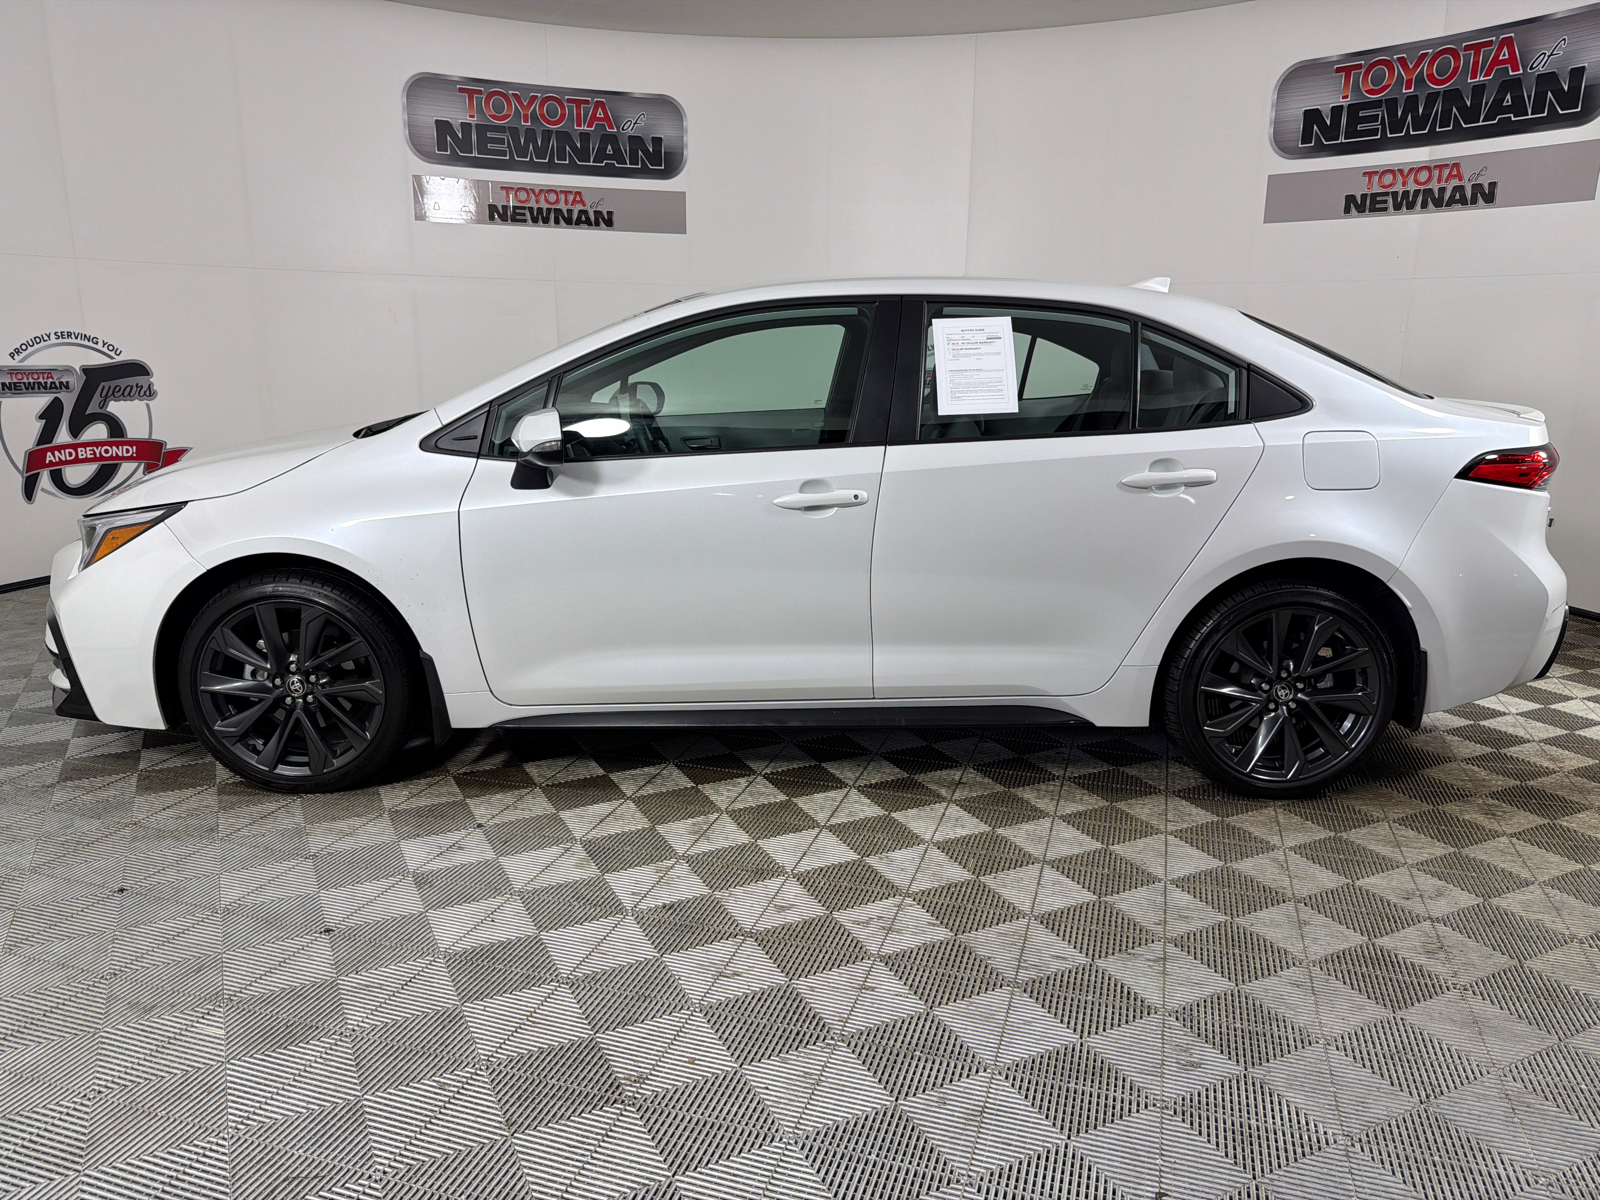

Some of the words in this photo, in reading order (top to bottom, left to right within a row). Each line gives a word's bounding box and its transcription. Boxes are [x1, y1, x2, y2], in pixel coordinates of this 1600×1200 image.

[1334, 33, 1522, 101] TOYOTA
[1528, 36, 1567, 73] of
[457, 86, 616, 131] TOYOTA
[620, 112, 646, 133] of
[1299, 63, 1588, 147] NEWNAN
[434, 118, 664, 169] NEWNAN
[1362, 161, 1464, 191] TOYOTA
[1468, 165, 1487, 183] of
[500, 186, 586, 208] TOYOTA
[590, 197, 604, 209] of
[1343, 180, 1498, 216] NEWNAN
[488, 203, 614, 228] NEWNAN
[8, 332, 52, 361] PROUDLY
[54, 331, 99, 346] SERVING
[101, 340, 123, 357] YOU
[1, 381, 70, 391] NEWNAN
[7, 371, 55, 381] TOYOTA
[98, 381, 156, 410] years
[23, 360, 153, 503] 15
[45, 449, 76, 464] AND
[78, 446, 137, 460] BEYOND!
